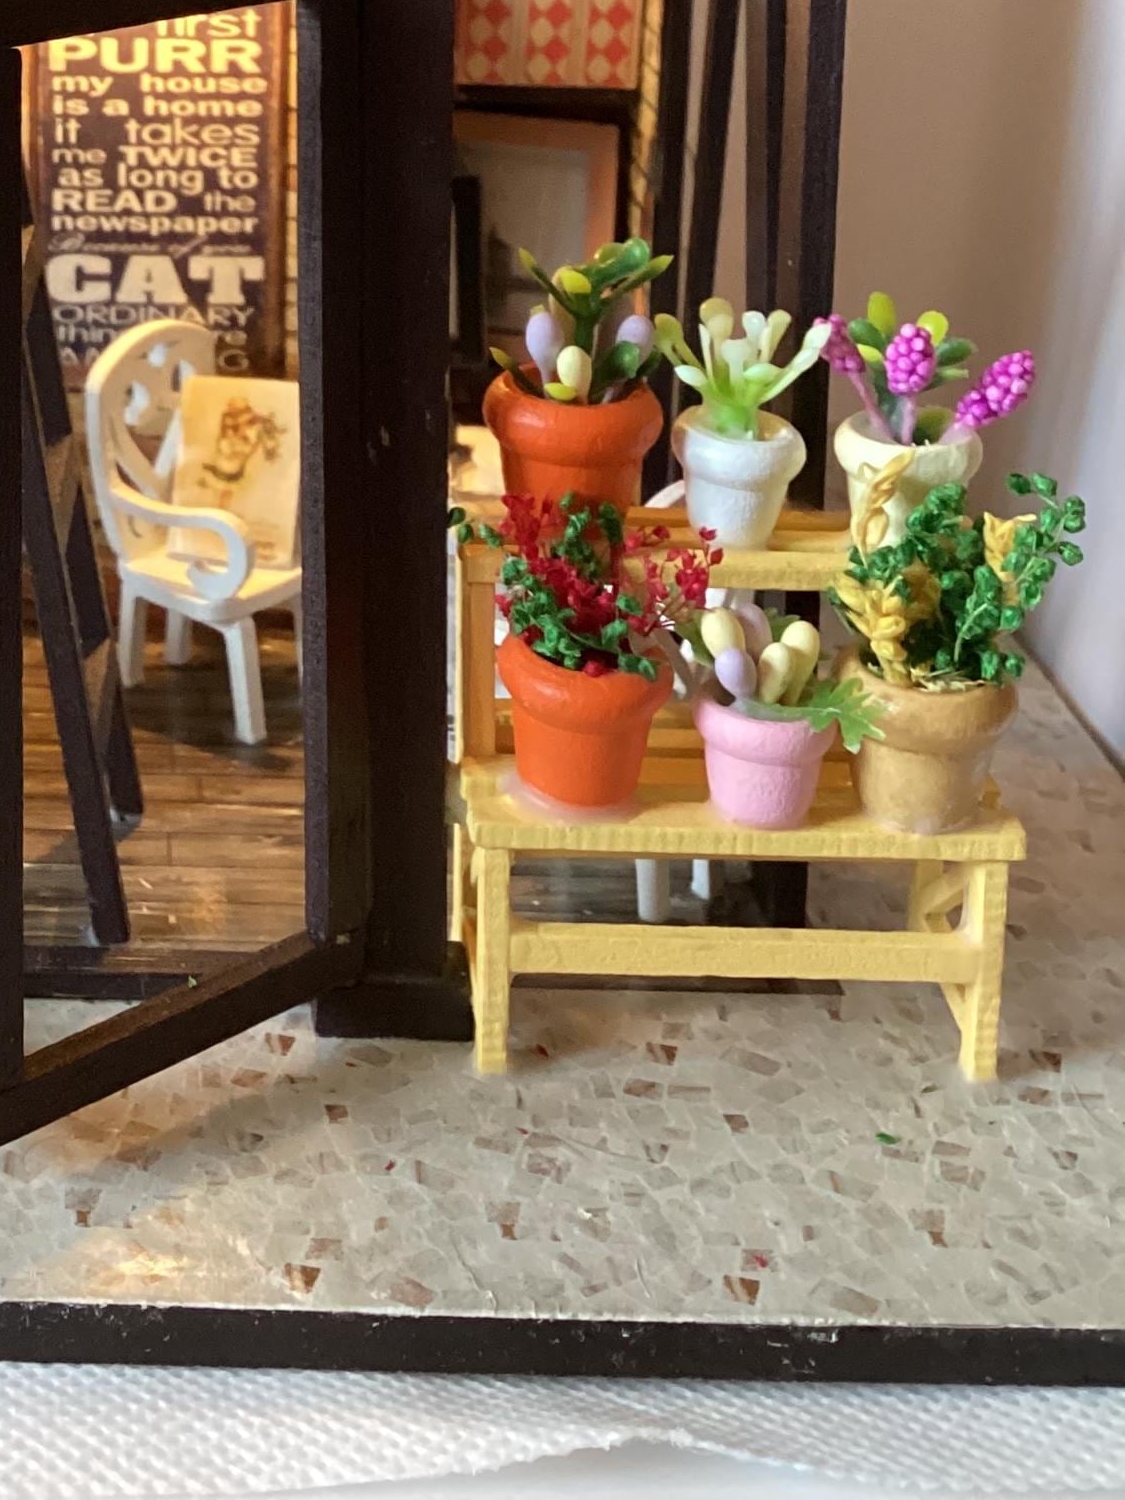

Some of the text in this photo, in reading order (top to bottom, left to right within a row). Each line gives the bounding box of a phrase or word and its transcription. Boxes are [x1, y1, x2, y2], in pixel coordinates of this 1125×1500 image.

[48, 35, 263, 74] PURR
[51, 71, 268, 98] my house
[51, 94, 264, 118] is a home
[53, 116, 261, 146] it takes
[51, 145, 259, 169] me TWICE
[57, 162, 260, 196] as long to
[51, 189, 257, 214] READ the
[51, 214, 259, 237] newspaper
[44, 252, 266, 306] CAT
[51, 303, 256, 327] ORDINARY
